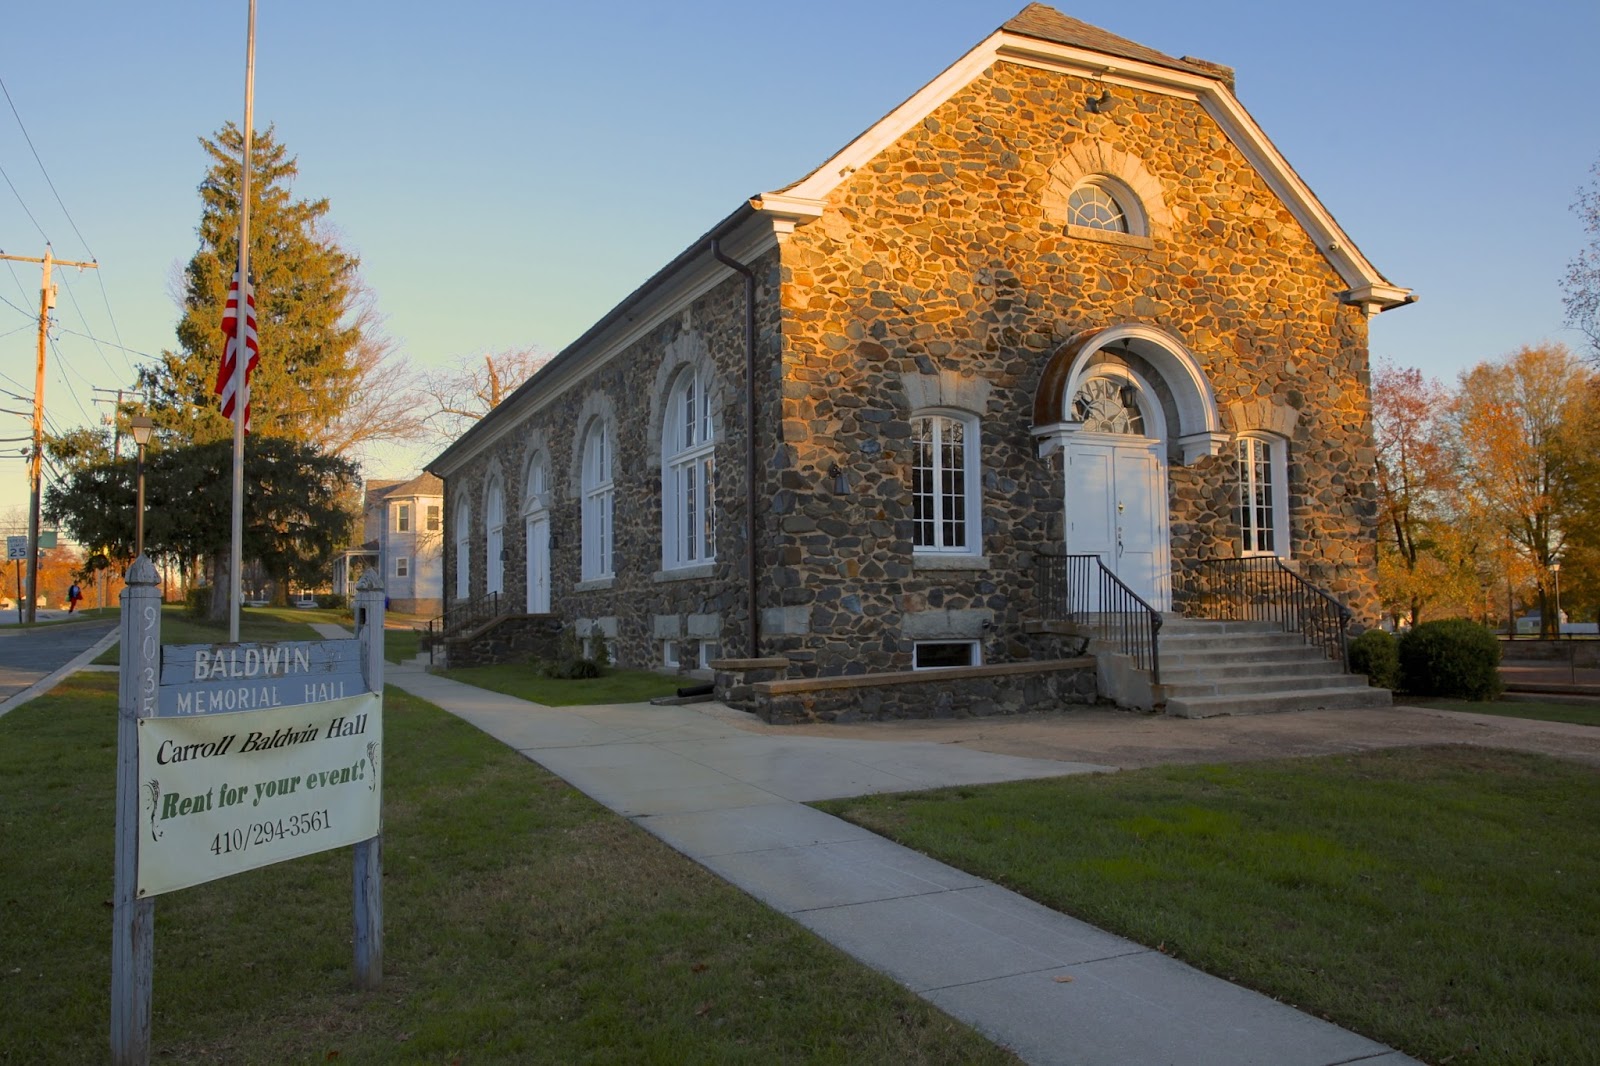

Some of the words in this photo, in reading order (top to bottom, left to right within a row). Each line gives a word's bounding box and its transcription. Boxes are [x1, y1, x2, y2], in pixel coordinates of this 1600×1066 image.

[10, 548, 26, 557] 25
[194, 646, 309, 680] BALDWIN
[177, 685, 282, 714] MEMORIAL
[156, 734, 236, 766] Carroll
[238, 723, 319, 753] Baldwin
[325, 713, 368, 740] Hall
[160, 786, 213, 820] Rent
[217, 783, 249, 808] for
[252, 774, 302, 807] your
[306, 758, 366, 790] event!
[210, 809, 332, 856] 410/294-3561
